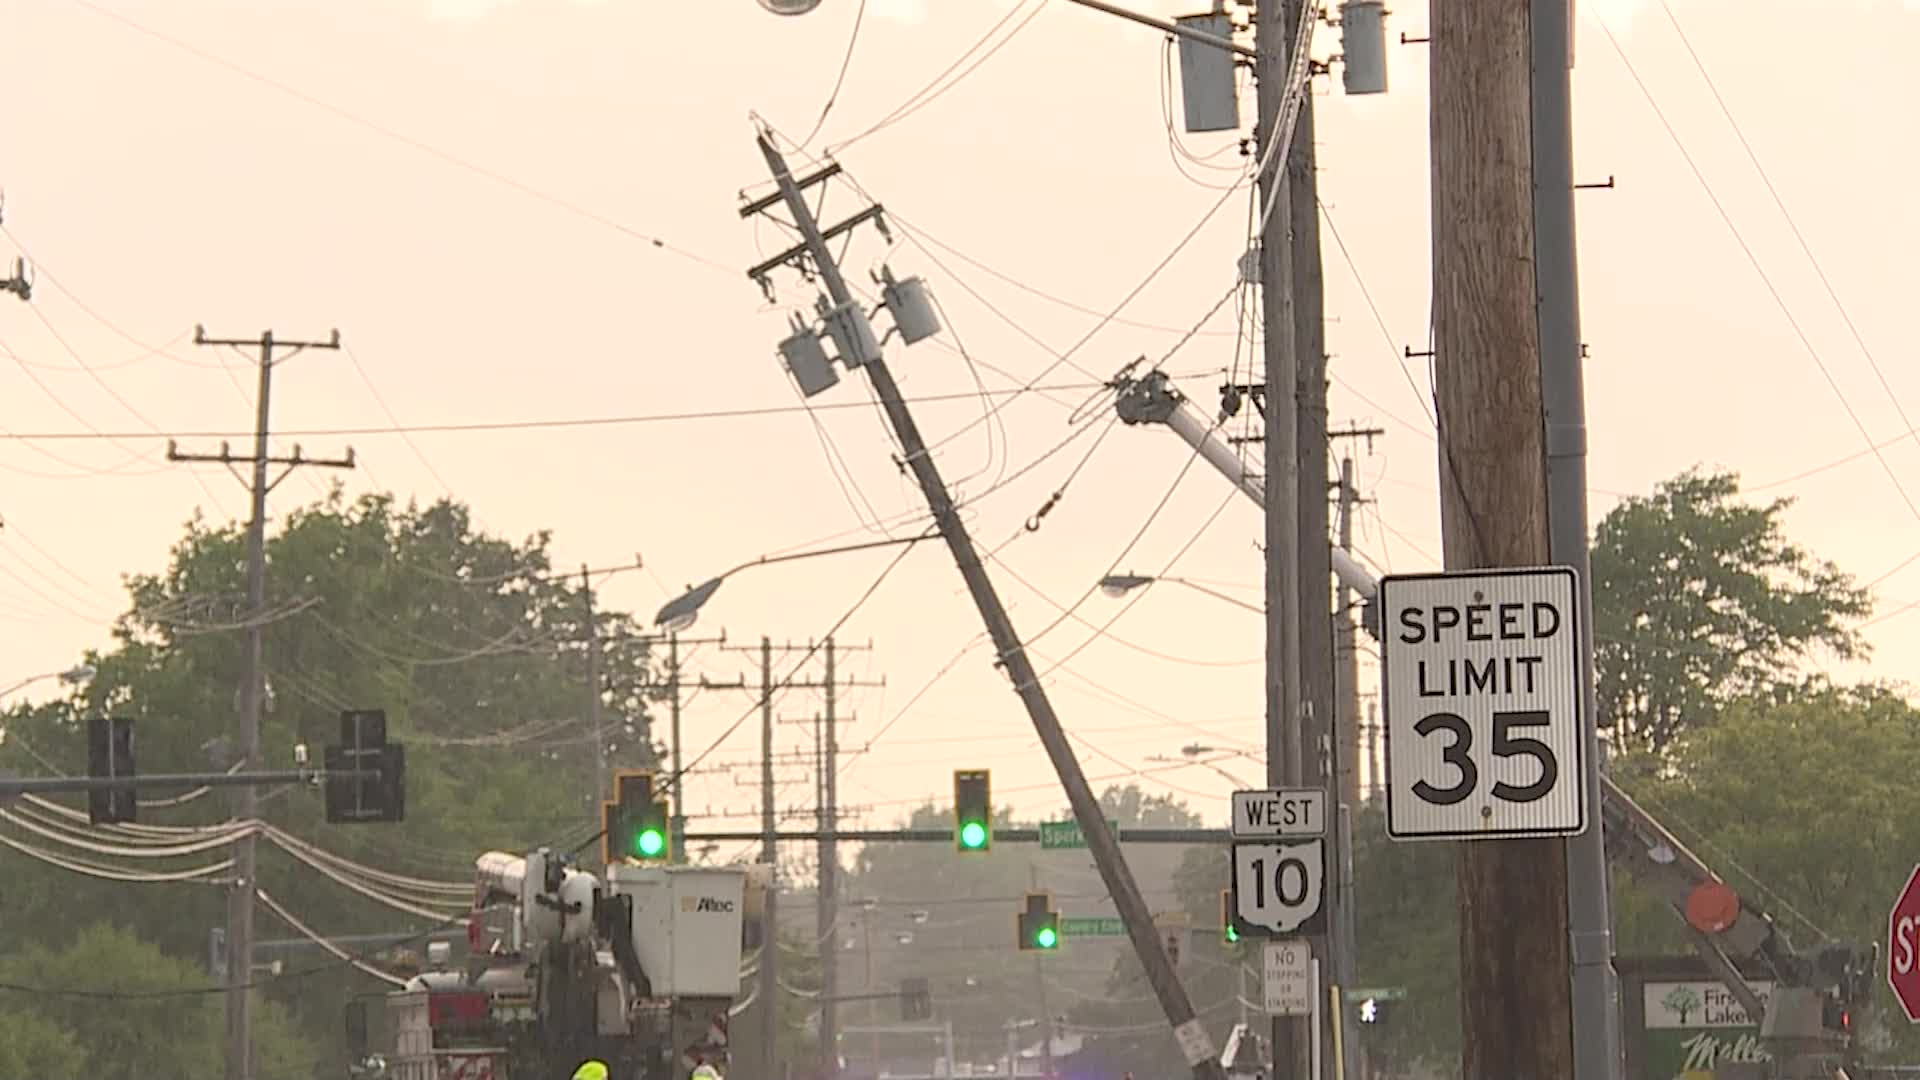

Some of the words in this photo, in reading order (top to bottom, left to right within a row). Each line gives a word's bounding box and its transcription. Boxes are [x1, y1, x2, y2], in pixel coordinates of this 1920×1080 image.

[1399, 602, 1561, 644] SPEED
[1418, 656, 1543, 697] LIMIT
[1411, 710, 1558, 806] 35
[1245, 799, 1313, 826] WEST
[1251, 857, 1309, 909] 10
[1274, 951, 1295, 966] NO
[1704, 1006, 1746, 1025] Lake
